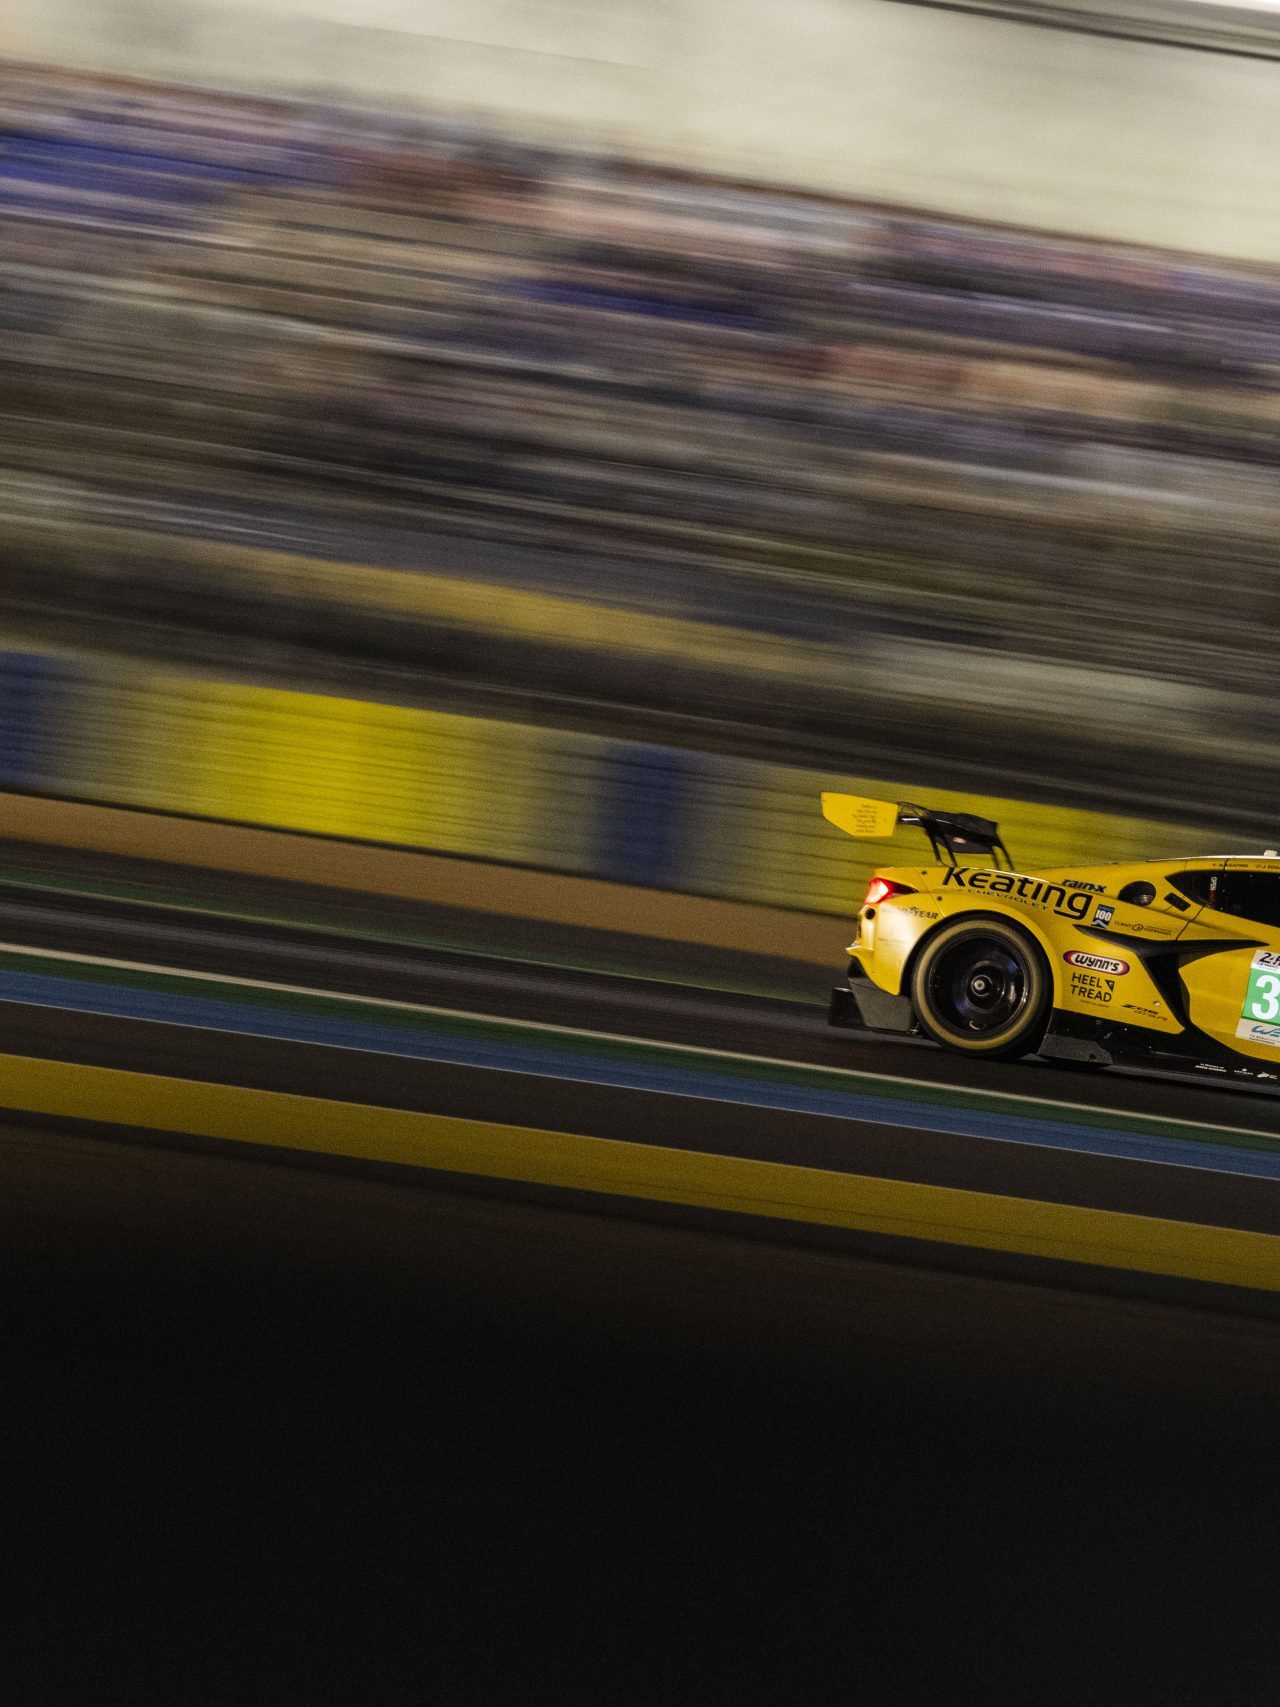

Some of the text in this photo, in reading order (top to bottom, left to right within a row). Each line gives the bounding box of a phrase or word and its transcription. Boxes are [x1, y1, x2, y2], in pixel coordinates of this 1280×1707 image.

[942, 867, 1094, 921] Keating
[967, 888, 1049, 911] CHEVROLET
[1095, 909, 1112, 921] 100
[1071, 972, 1103, 989] HEEL
[1070, 984, 1112, 1003] TREAD
